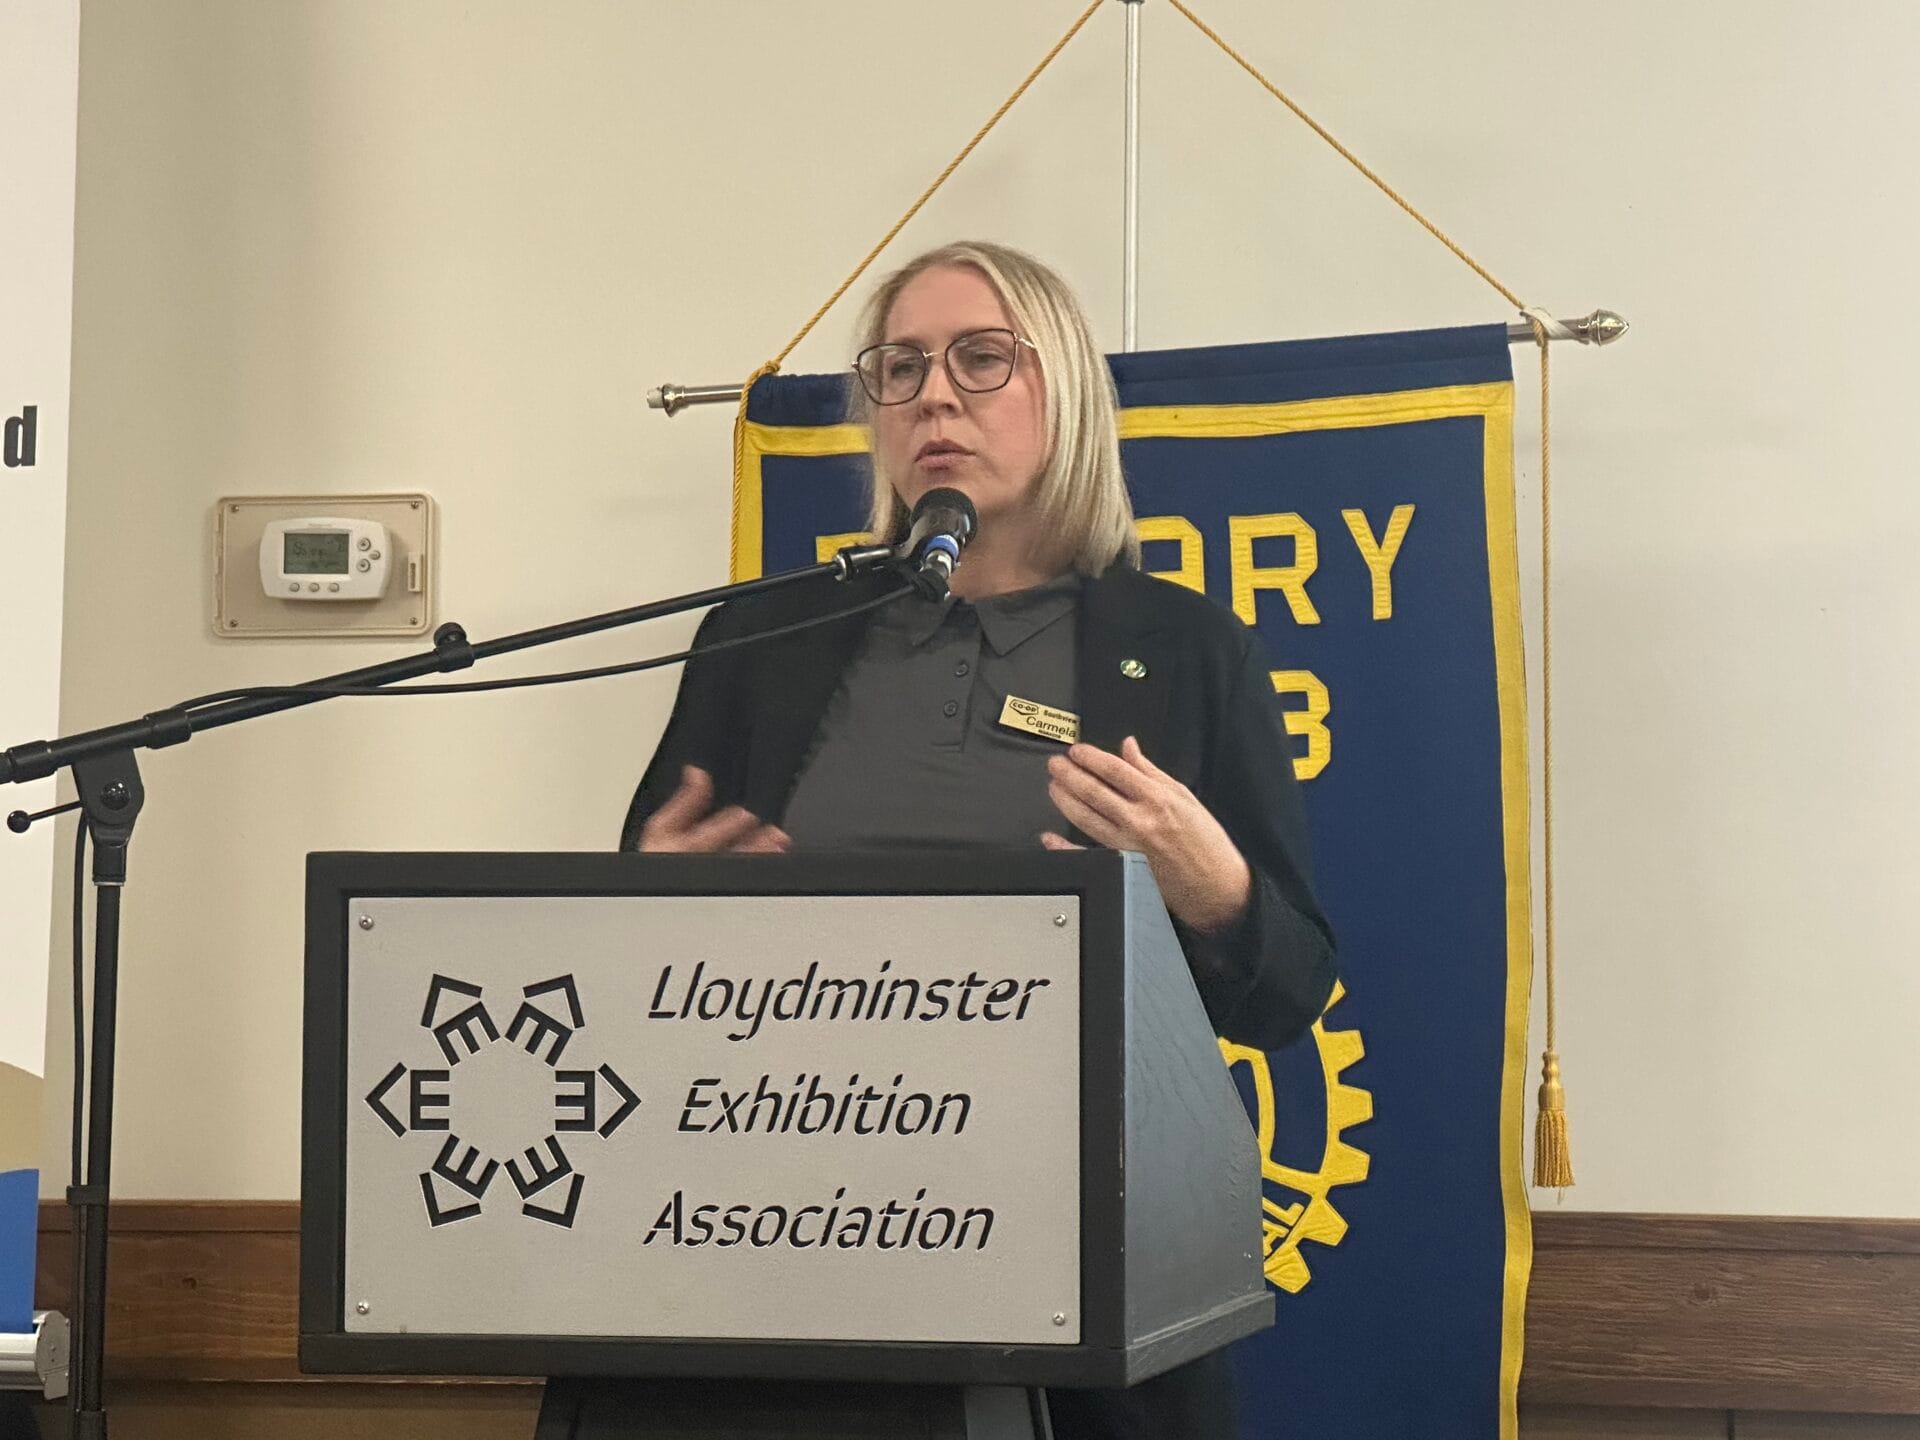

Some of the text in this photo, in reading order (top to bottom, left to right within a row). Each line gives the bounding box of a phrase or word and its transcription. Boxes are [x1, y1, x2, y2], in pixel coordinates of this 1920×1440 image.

[1012, 701, 1037, 713] CO-OP
[1026, 716, 1077, 738] Carmela
[647, 960, 1051, 1042] Lloydminster
[676, 1073, 972, 1135] Exhibition
[642, 1187, 996, 1250] Association
